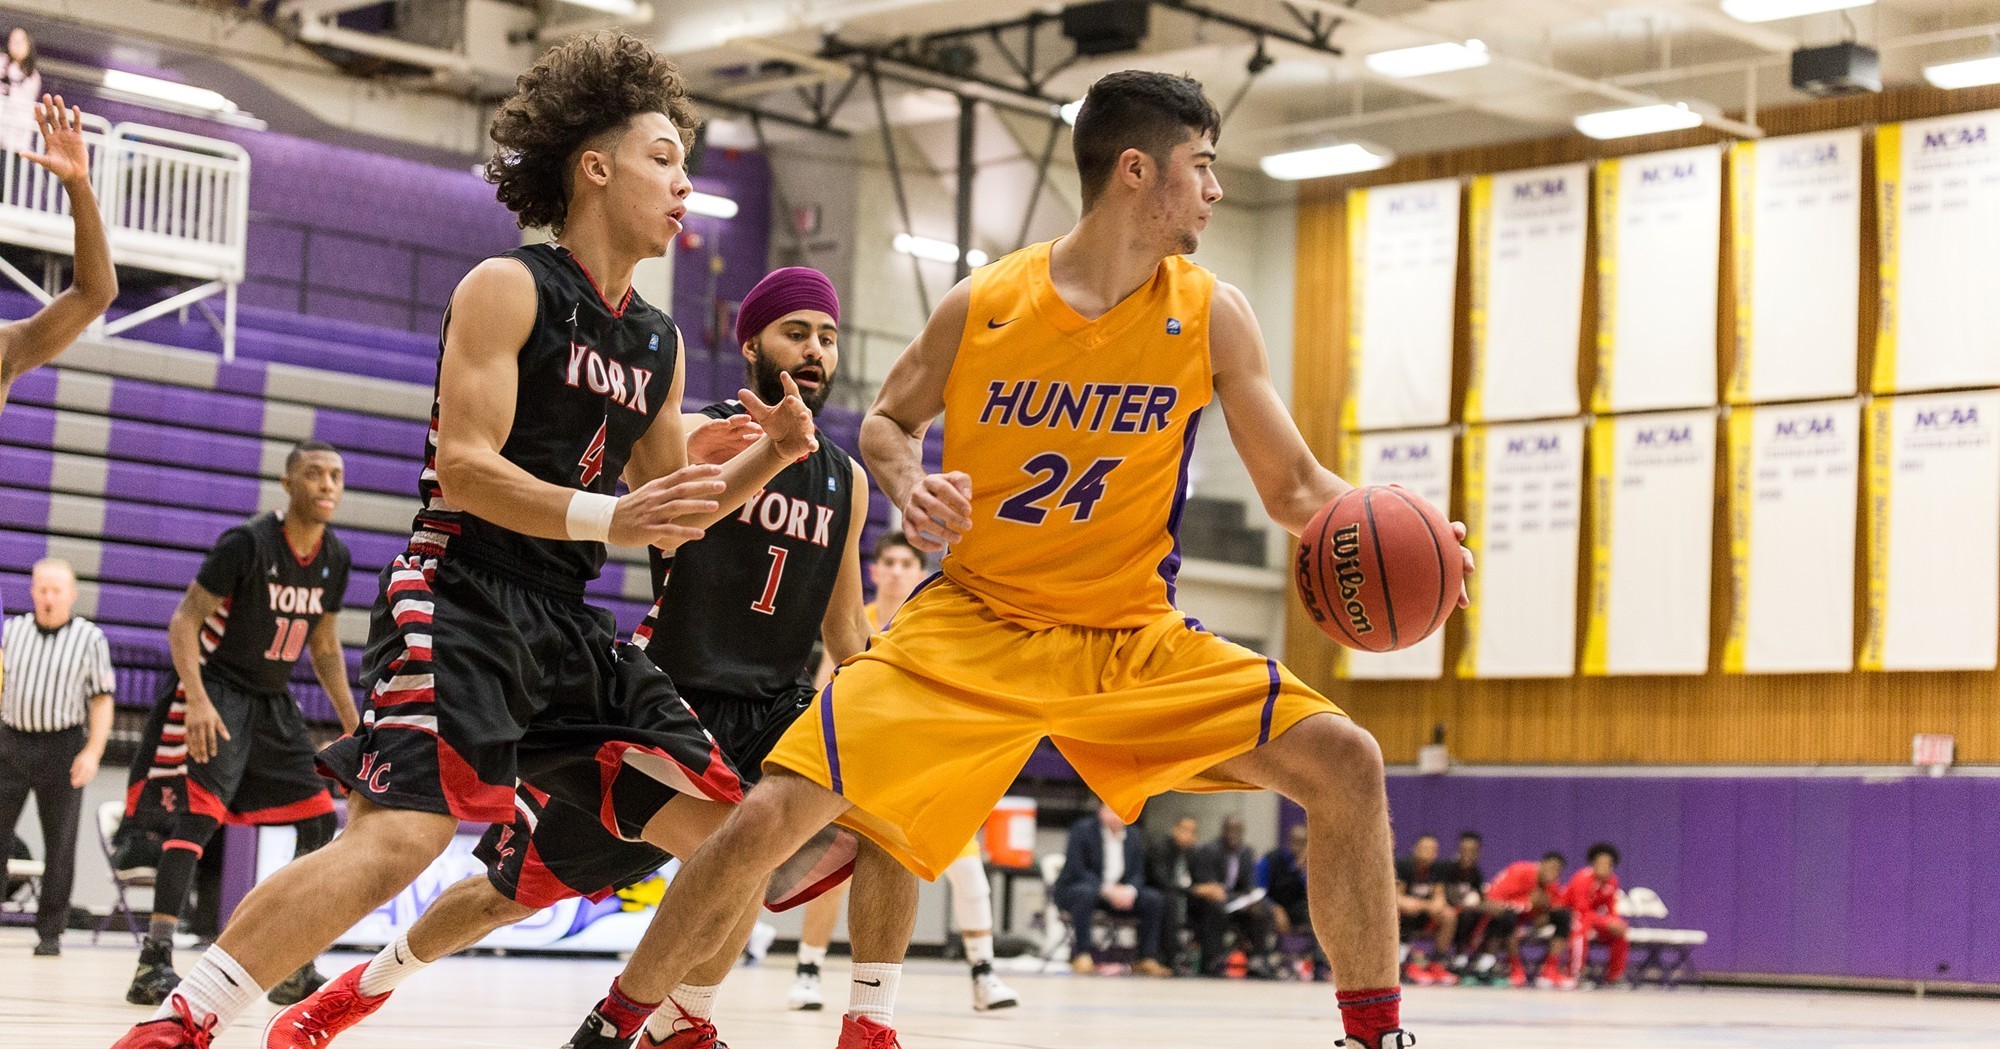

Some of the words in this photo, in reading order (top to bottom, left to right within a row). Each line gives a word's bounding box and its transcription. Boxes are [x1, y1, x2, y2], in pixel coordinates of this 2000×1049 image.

[1922, 125, 1987, 150] NCAA
[564, 340, 653, 416] YORK
[977, 379, 1179, 435] HUNTER
[1775, 415, 1835, 439] NCAA
[1915, 406, 1979, 431] NCAA
[577, 414, 608, 488] 4
[1507, 434, 1560, 455] NCAA
[1636, 425, 1692, 446] NCAA
[994, 450, 1127, 527] 24
[737, 487, 835, 548] YORK
[268, 582, 325, 615] YORK
[750, 545, 789, 616] 1
[1298, 543, 1327, 623] NCAA
[1331, 522, 1375, 636] Wilson
[264, 616, 309, 662] 10
